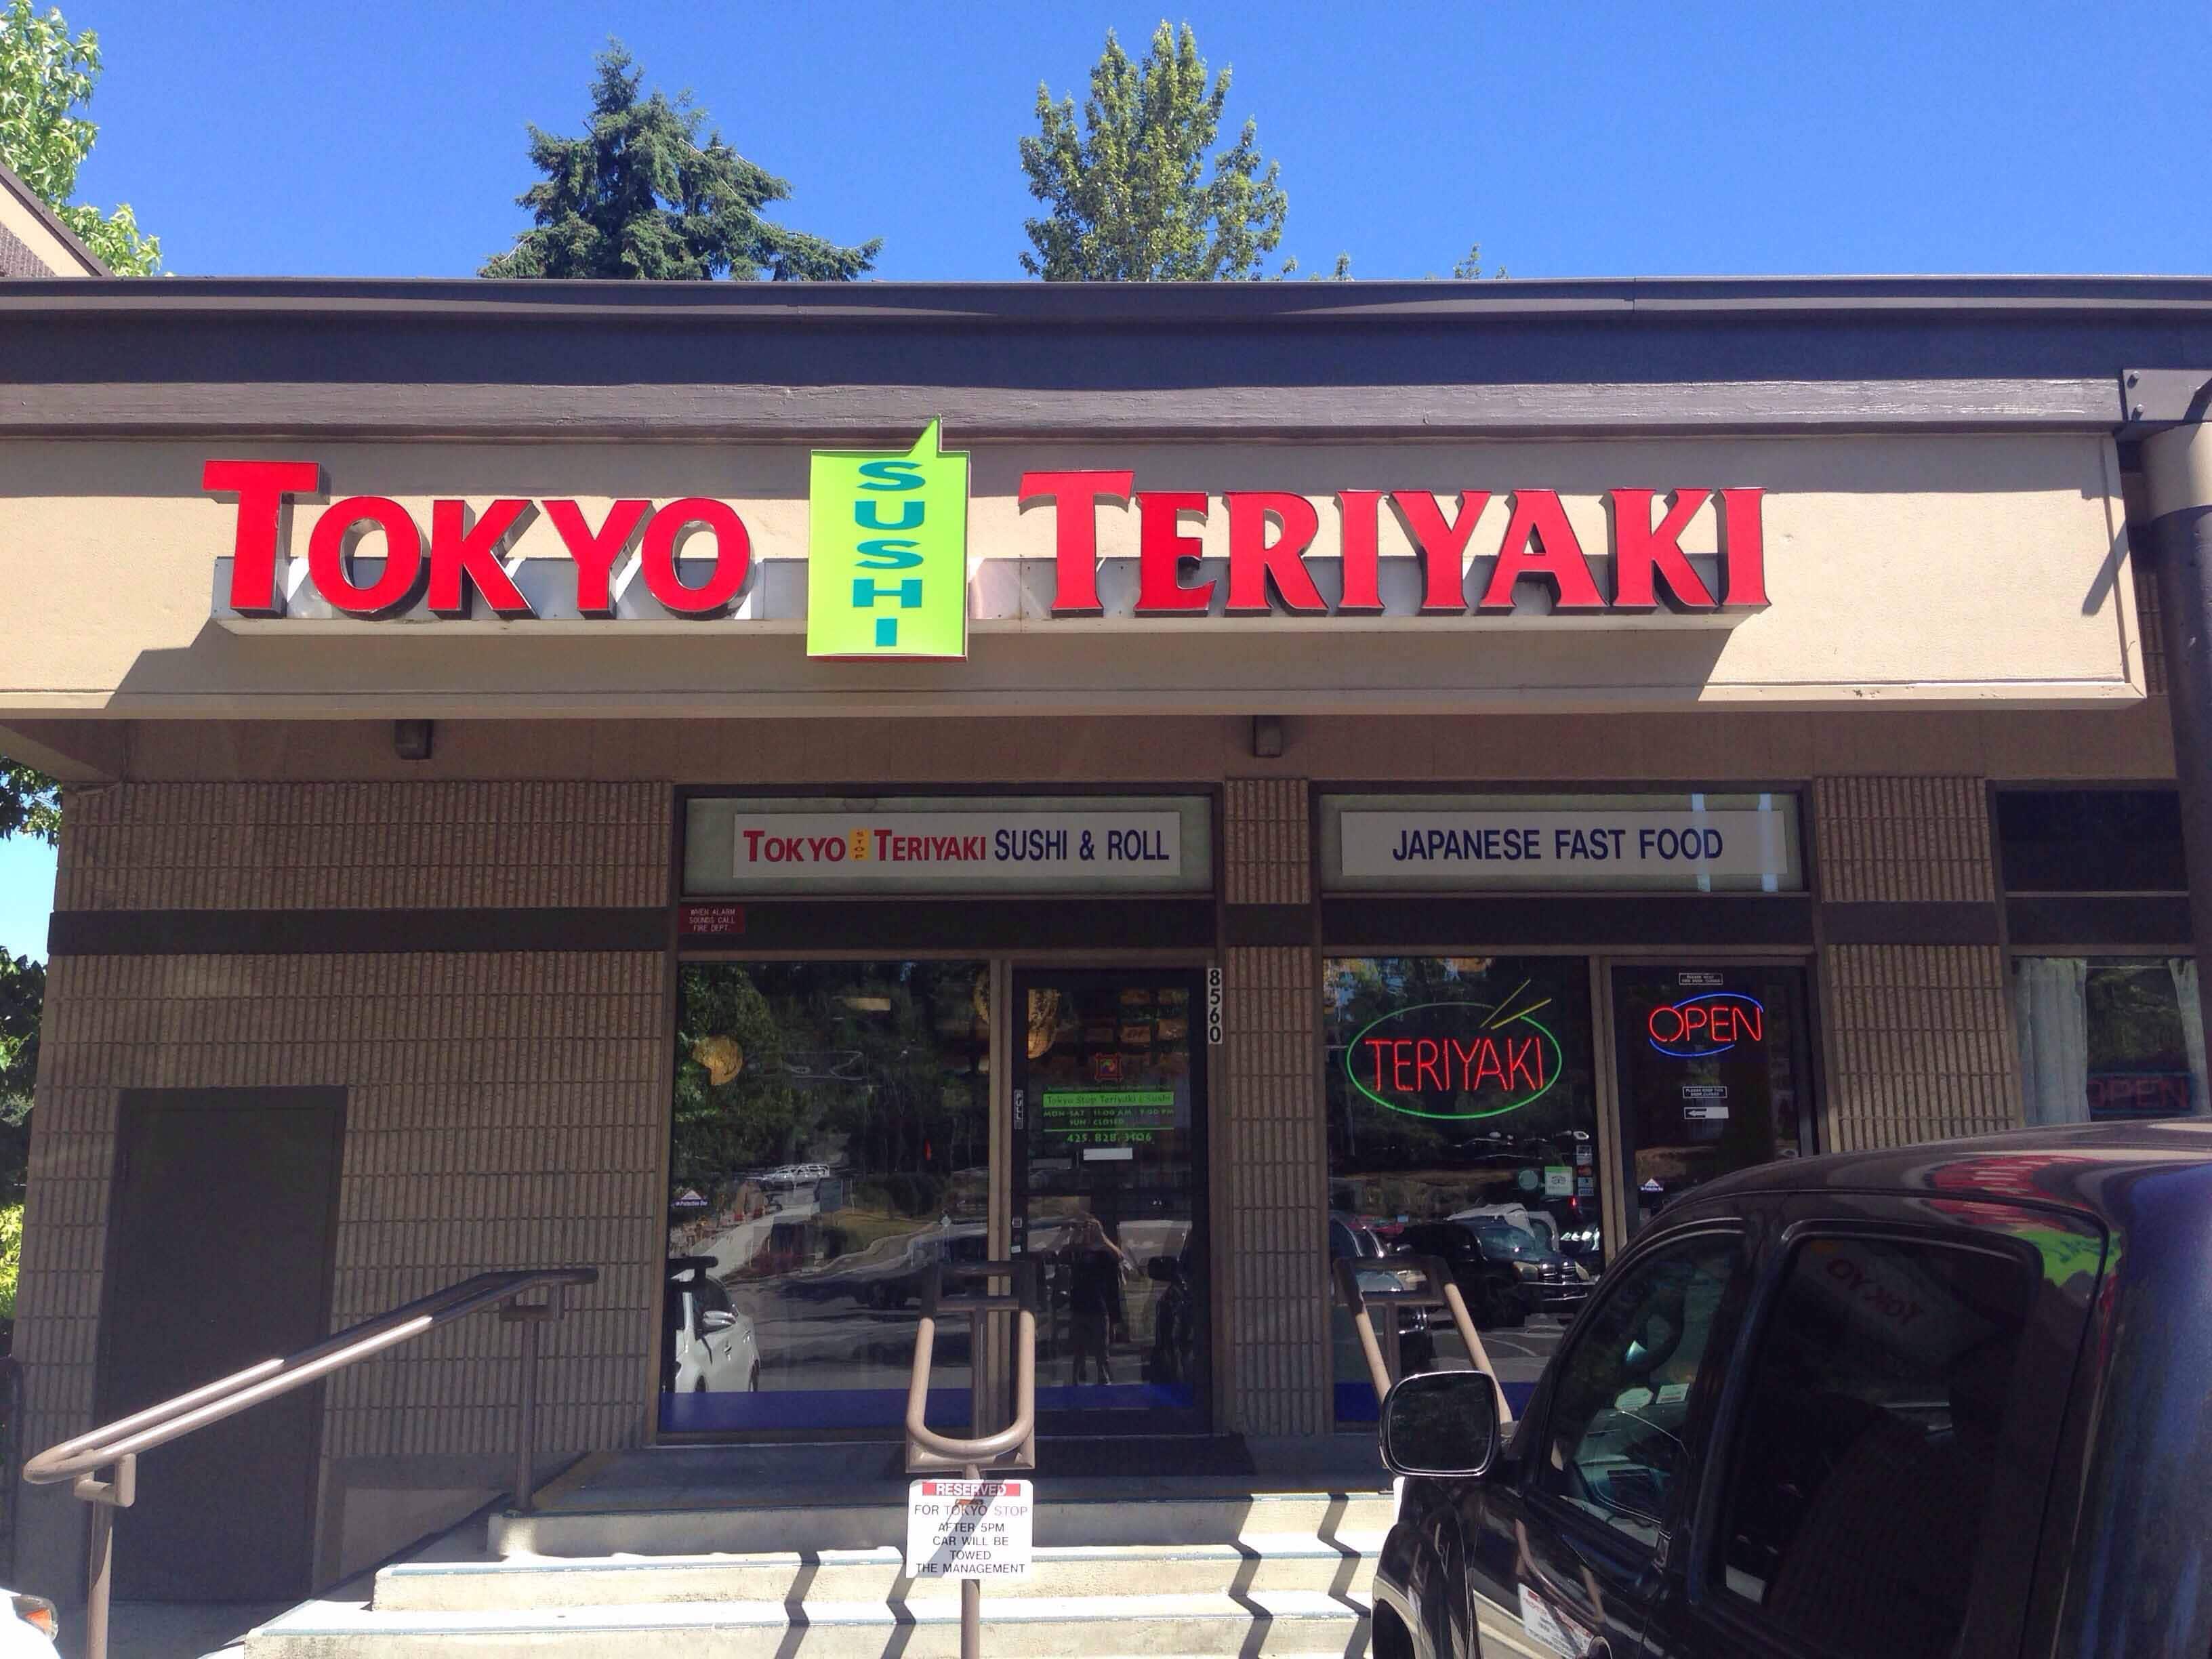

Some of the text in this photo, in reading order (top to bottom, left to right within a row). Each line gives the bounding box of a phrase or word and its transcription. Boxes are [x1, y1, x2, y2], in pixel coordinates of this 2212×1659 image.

[203, 460, 751, 613] TOKYO
[1020, 470, 1770, 613] TERIYAKI
[853, 461, 926, 647] SUSHI
[743, 830, 846, 861] TOKYO
[874, 830, 1169, 861] TERIYAKI SUSHI & ROLL
[1393, 829, 1723, 861] JAPANESE FAST FOOD
[1209, 969, 1221, 1042] 8560
[1648, 1006, 1763, 1042] OPEN
[1364, 1036, 1544, 1092] TERIYAKI
[936, 1483, 1006, 1496] RESERVED
[914, 1504, 1028, 1517] FOR TOKYO STOP
[933, 1536, 1009, 1546] CAR WILL BE
[938, 1523, 1004, 1532] AFTER 5PM
[916, 1563, 1025, 1573] THE MANAGEMENT
[949, 1551, 991, 1560] TOWED
